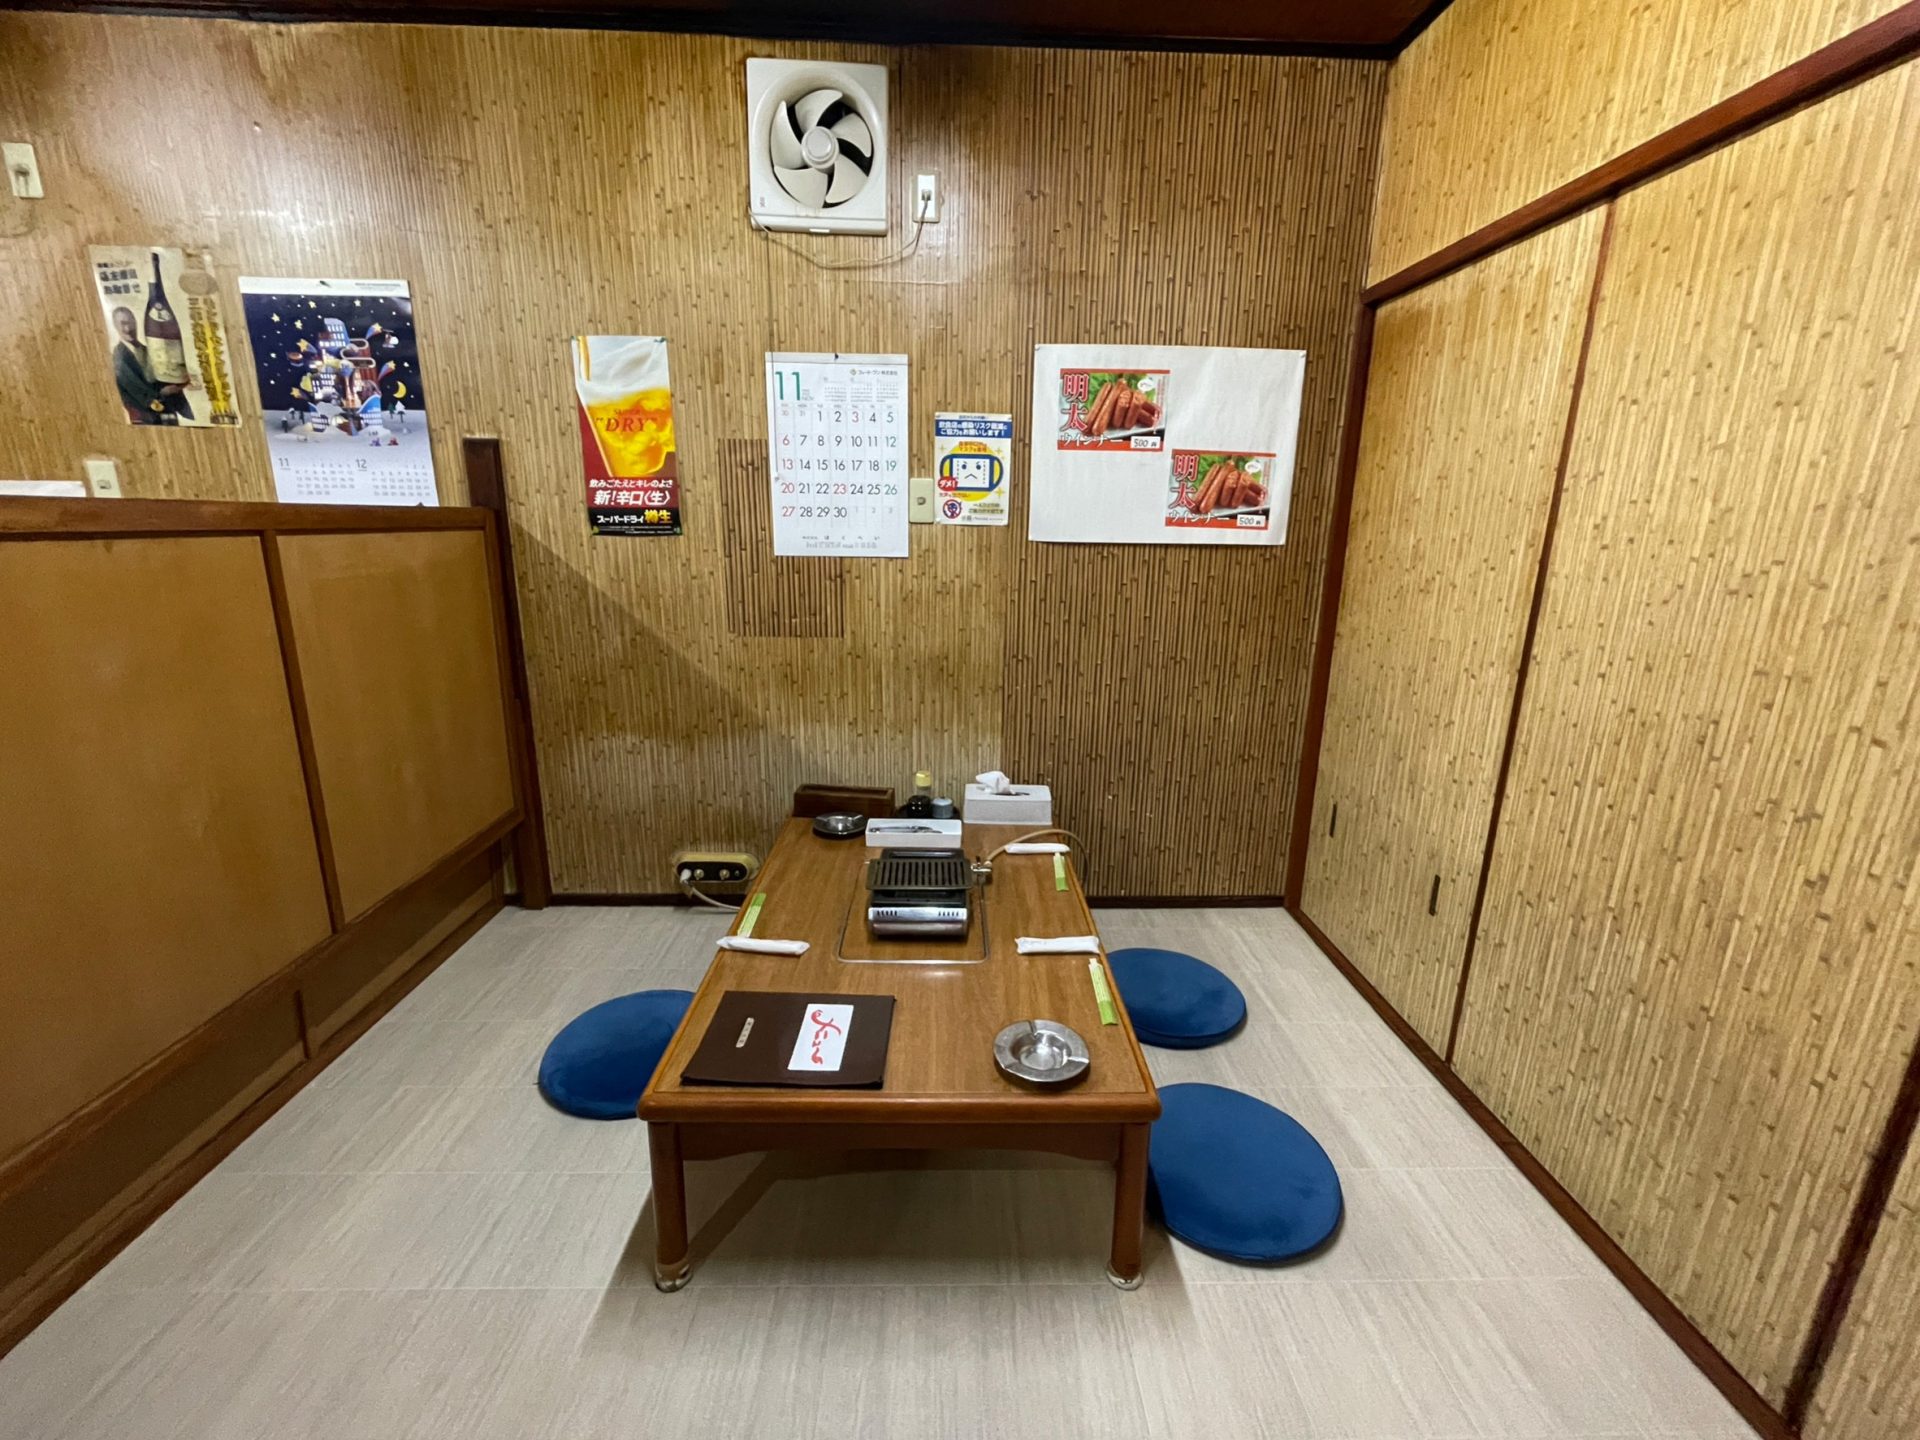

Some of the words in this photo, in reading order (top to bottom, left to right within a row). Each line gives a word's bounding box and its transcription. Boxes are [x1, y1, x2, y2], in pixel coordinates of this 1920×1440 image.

[775, 371, 801, 401] 11
[1061, 373, 1089, 433] 明太
[818, 411, 822, 421] 1
[835, 411, 842, 422] 2
[852, 411, 858, 423] 3
[869, 412, 876, 423] 4
[887, 412, 893, 423] 5
[783, 435, 790, 446] 6
[800, 436, 807, 445] 7
[818, 436, 824, 446] 8
[835, 436, 842, 446] 9
[851, 436, 862, 447] 10
[868, 437, 878, 446] 11
[886, 437, 896, 447] 12
[1133, 439, 1149, 448] 500
[278, 458, 289, 467] 11
[356, 459, 367, 468] 12
[782, 459, 793, 469] 13
[799, 460, 810, 470] 14
[817, 460, 828, 470] 15
[834, 460, 845, 470] 16
[852, 460, 862, 470] 17
[869, 460, 879, 470] 18
[886, 461, 896, 471] 19
[589, 479, 673, 488] 飲みごたえとキレのよさ
[1170, 454, 1198, 509] 明太
[781, 483, 794, 493] 20
[799, 483, 810, 494] 21
[816, 483, 829, 494] 22
[834, 484, 847, 494] 23
[851, 484, 863, 494] 24
[868, 484, 880, 494] 25
[884, 484, 897, 494] 26
[782, 507, 795, 517] 27
[800, 507, 813, 517] 28
[817, 507, 829, 518] 29
[834, 508, 847, 518] 30
[1239, 516, 1254, 525] 500
